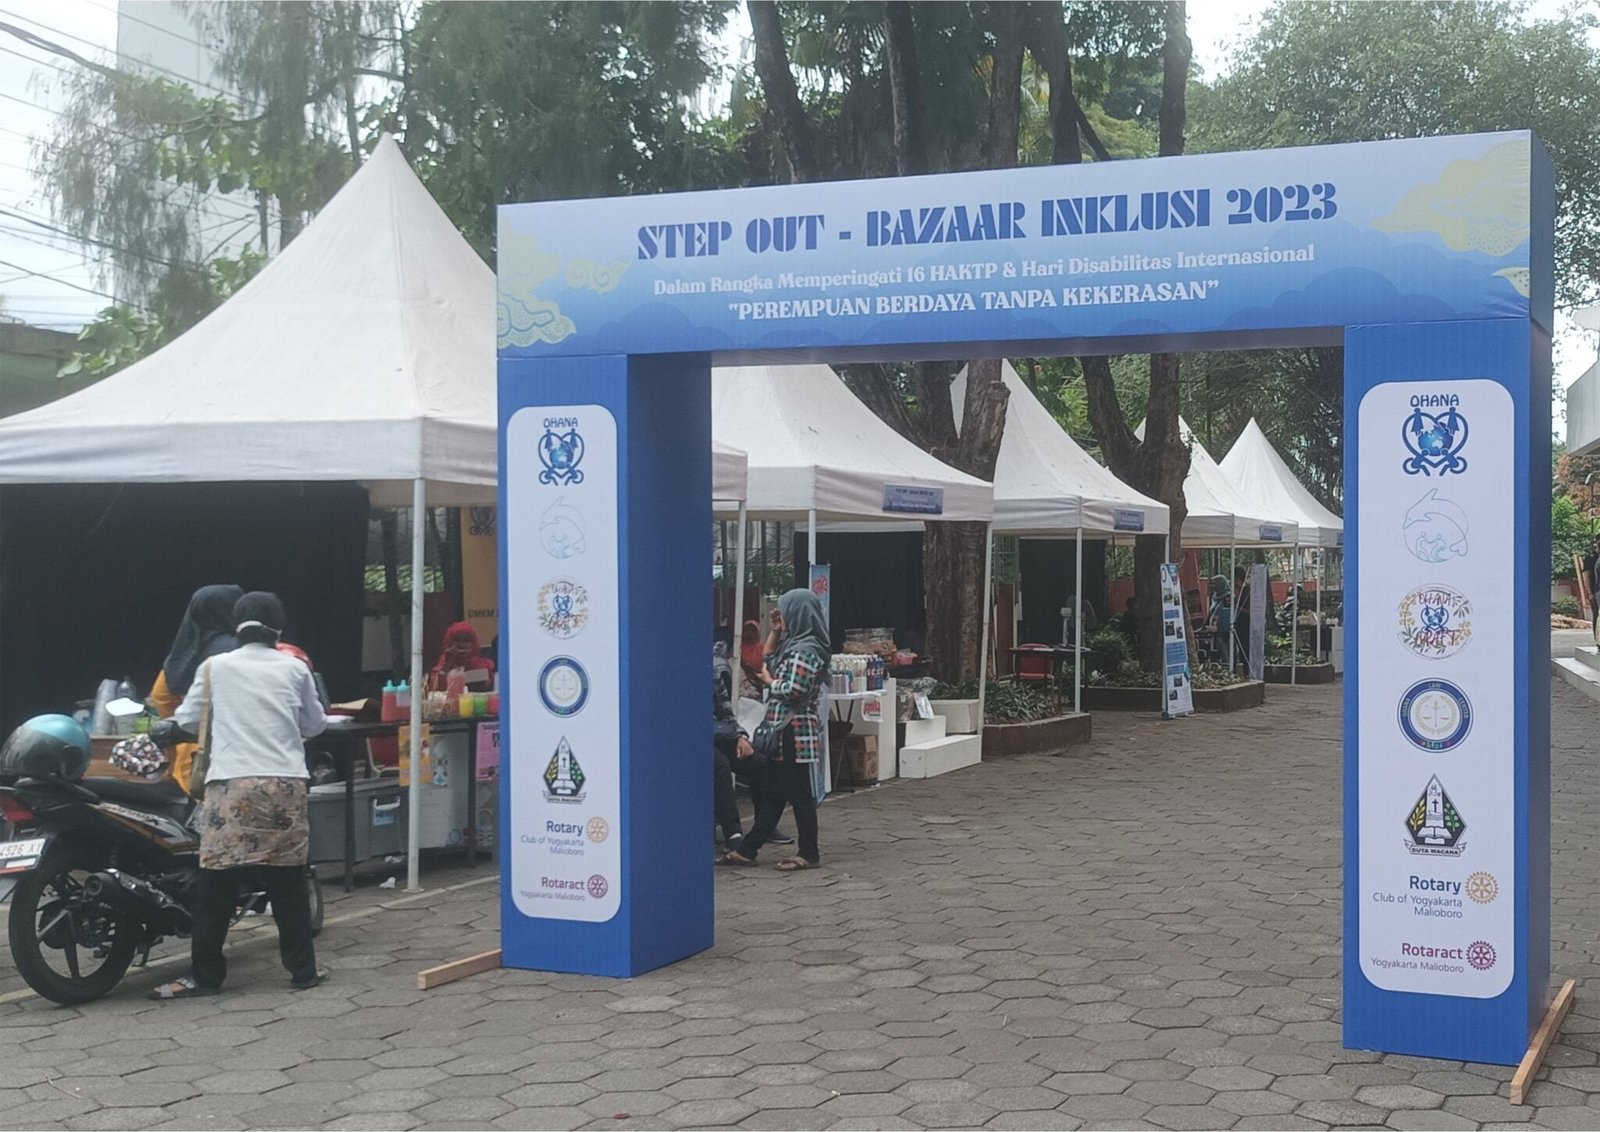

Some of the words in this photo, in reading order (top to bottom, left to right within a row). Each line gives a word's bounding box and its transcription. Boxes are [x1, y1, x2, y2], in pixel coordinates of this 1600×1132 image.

[638, 221, 732, 260] STEP
[746, 215, 825, 254] OUT
[839, 231, 851, 240] -
[866, 202, 1027, 247] BAZAAR
[1041, 189, 1210, 237] INKLUSI
[1226, 182, 1338, 225] 2023
[654, 279, 706, 295] Dalam
[710, 275, 773, 294] Rangka
[777, 267, 902, 292] Memperingati
[907, 266, 925, 282] 16
[930, 262, 998, 281] HAKTP
[1002, 261, 1017, 278] &
[1022, 259, 1064, 277] Hari
[1068, 252, 1172, 275] Disabilitas
[1177, 243, 1315, 269] Internasional
[876, 292, 977, 315] BERDAYA
[981, 289, 1057, 310] TANPA
[1410, 394, 1460, 407] OHANA
[543, 417, 579, 428] OHANA
[546, 820, 584, 837] Rotary
[520, 834, 537, 844] Club
[539, 836, 546, 845] of
[541, 876, 585, 891] Rotaract
[1409, 875, 1462, 896] Rotary
[1372, 892, 1395, 903] Club
[1397, 893, 1408, 904] of
[1410, 894, 1463, 908] Yogyakarta
[1414, 906, 1463, 919] Malioboro
[1401, 942, 1463, 960] Rotaract
[1371, 957, 1418, 970] Yogyakarta
[1420, 961, 1464, 974] Malioboro
